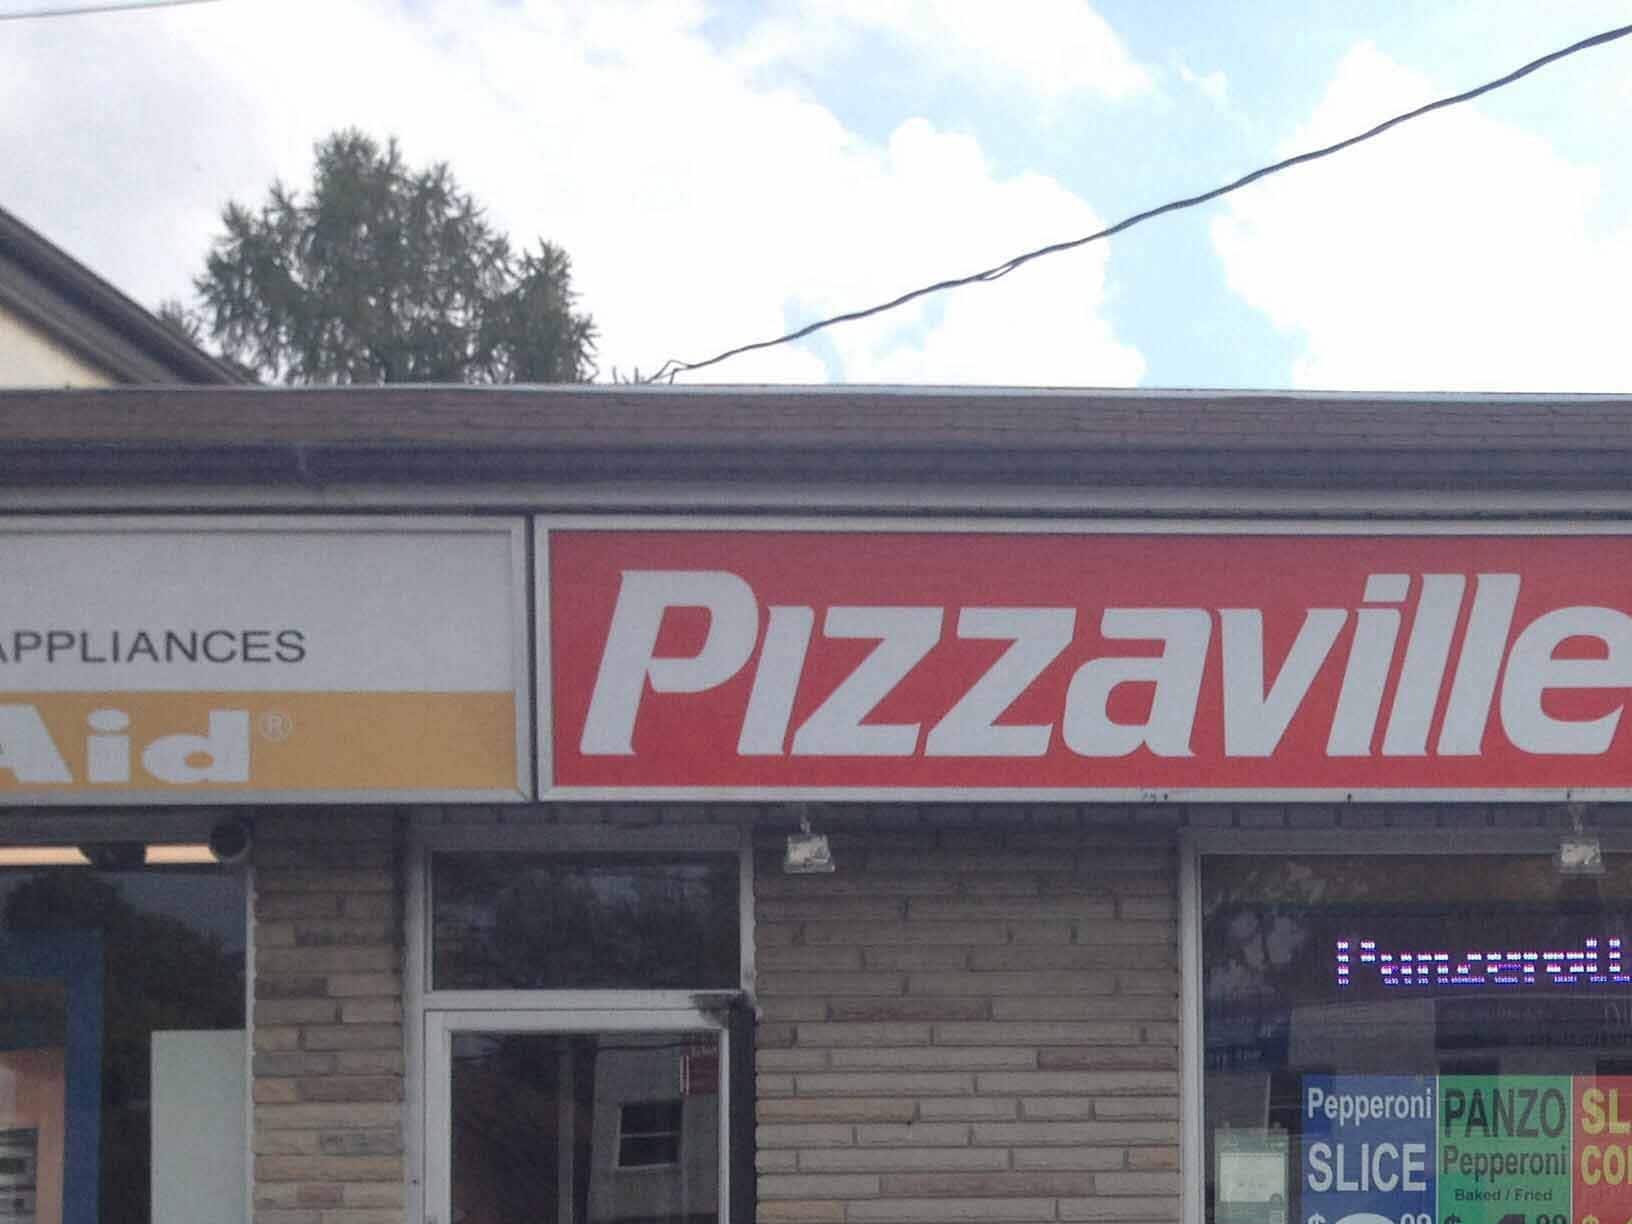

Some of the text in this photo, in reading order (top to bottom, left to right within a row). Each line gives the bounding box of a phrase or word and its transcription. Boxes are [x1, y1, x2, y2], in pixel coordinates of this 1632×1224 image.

[0, 629, 307, 663] PPLIANCES
[1307, 1087, 1432, 1127] Pepperoni
[1444, 1087, 1567, 1138] PANZO
[1307, 1142, 1427, 1193] SLICE
[1443, 1145, 1567, 1183] Pepperoni
